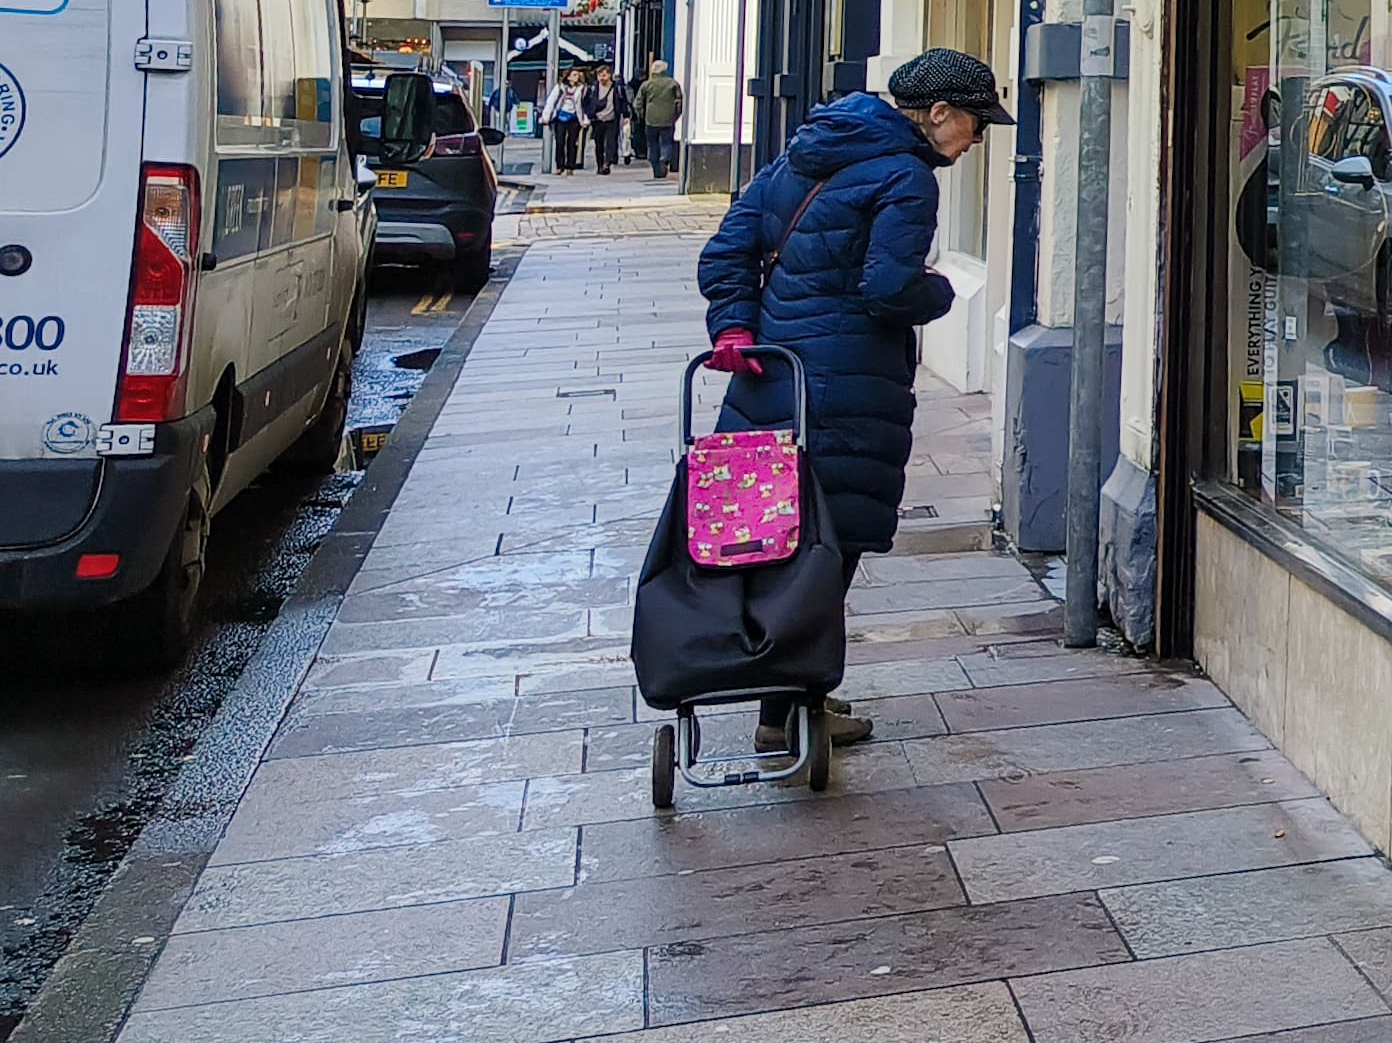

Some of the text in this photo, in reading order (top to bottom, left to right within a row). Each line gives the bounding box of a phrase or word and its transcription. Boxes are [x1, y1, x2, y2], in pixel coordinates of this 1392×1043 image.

[377, 172, 398, 186] FE
[0, 315, 66, 351] 00
[1247, 280, 1263, 376] EVERYTHING
